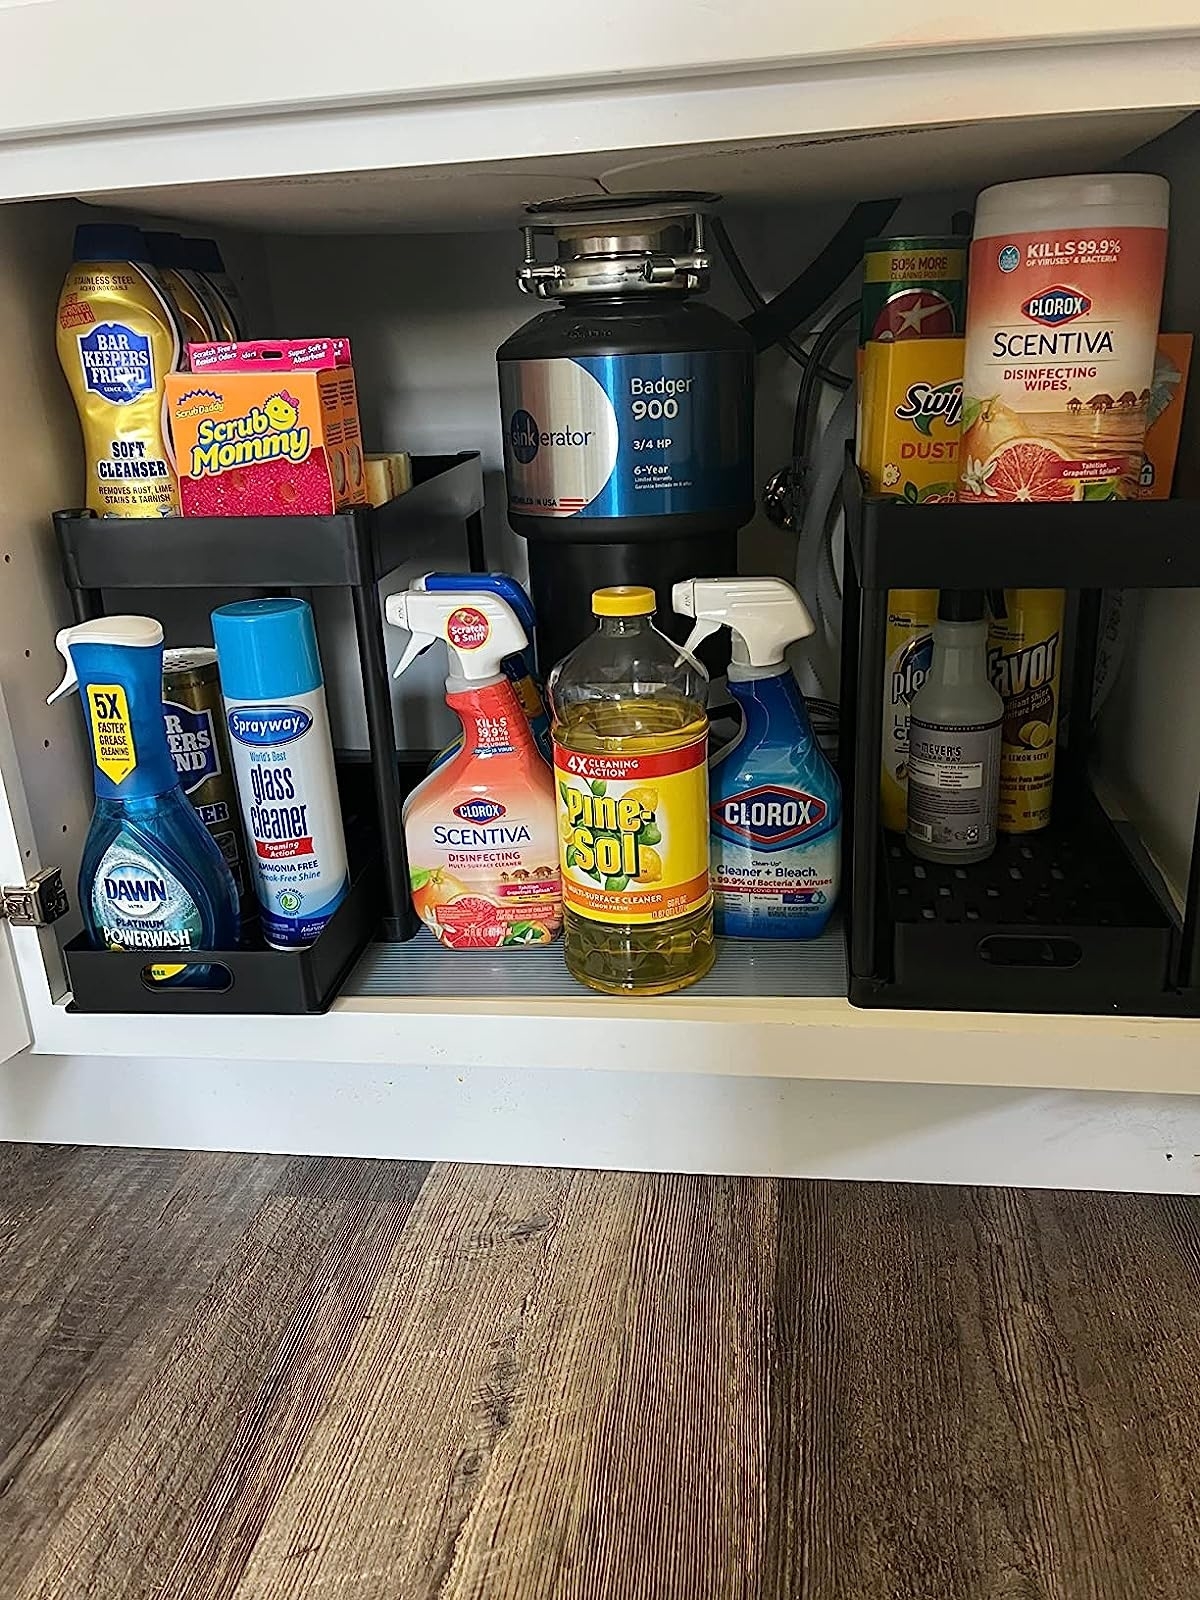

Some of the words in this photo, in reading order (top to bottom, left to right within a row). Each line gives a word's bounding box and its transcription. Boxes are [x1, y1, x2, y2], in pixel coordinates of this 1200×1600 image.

[1027, 243, 1075, 258] KILLS
[1077, 240, 1121, 254] 99.9%
[891, 257, 916, 271] 50%
[918, 256, 948, 270] MORE
[1026, 259, 1036, 267] OF
[1080, 255, 1117, 264] BACTERIA
[111, 275, 137, 285] STEEL
[1028, 296, 1084, 317] CLOROX
[96, 334, 130, 351] BAR
[992, 330, 1114, 358] SCENTIVA
[82, 350, 149, 368] KEEPERS
[288, 347, 306, 359] Super
[308, 344, 322, 354] Soft
[90, 367, 147, 384] FRIEND
[1003, 367, 1098, 380] DISINFECTING
[630, 376, 693, 397] Badger
[631, 399, 679, 420] 900
[198, 407, 269, 446] Scrub
[111, 441, 145, 458] SOFT
[192, 428, 310, 476] Mommy
[633, 439, 654, 451] 3/4
[656, 438, 672, 449] HP
[99, 460, 168, 478] CLEANSER
[633, 465, 669, 476] 6-Year
[98, 486, 131, 495] REMOVES
[104, 495, 130, 504] STAINS
[131, 495, 138, 504] &
[139, 494, 171, 503] TARNISH
[542, 498, 558, 507] USA
[451, 623, 486, 637] Scratch
[453, 634, 461, 643] &
[462, 632, 486, 643] Sniff
[93, 693, 122, 720] 5X
[97, 722, 127, 733] FASTER
[232, 715, 301, 737] Sprayway
[475, 716, 507, 728] KILLS
[99, 734, 128, 746] GREASE
[100, 747, 130, 757] CLEANING
[271, 751, 287, 761] Best
[567, 755, 589, 775] 4X
[588, 758, 639, 769] CLEANING
[250, 763, 295, 806] glass
[459, 804, 500, 818] CLOROX
[566, 786, 653, 833] Pine-
[724, 800, 813, 827] CLOROX
[250, 804, 308, 840] cleaner
[433, 825, 531, 845] SCENTIVA
[264, 841, 300, 851] Foaming
[269, 849, 296, 858] Action
[573, 827, 638, 876] Sol
[448, 851, 521, 862] DISINFECTING
[298, 859, 319, 871] FREE
[716, 864, 763, 877] Cleaner
[298, 870, 321, 882] Shine
[717, 876, 746, 886] 99.9%
[747, 878, 757, 887] of
[803, 877, 833, 887] Viruses
[103, 877, 168, 902] DAWN
[567, 884, 621, 904] MULTI-SURFACE
[621, 894, 663, 905] CLEANER
[115, 918, 165, 929] PLATINUM
[102, 926, 191, 948] POWERWASH
